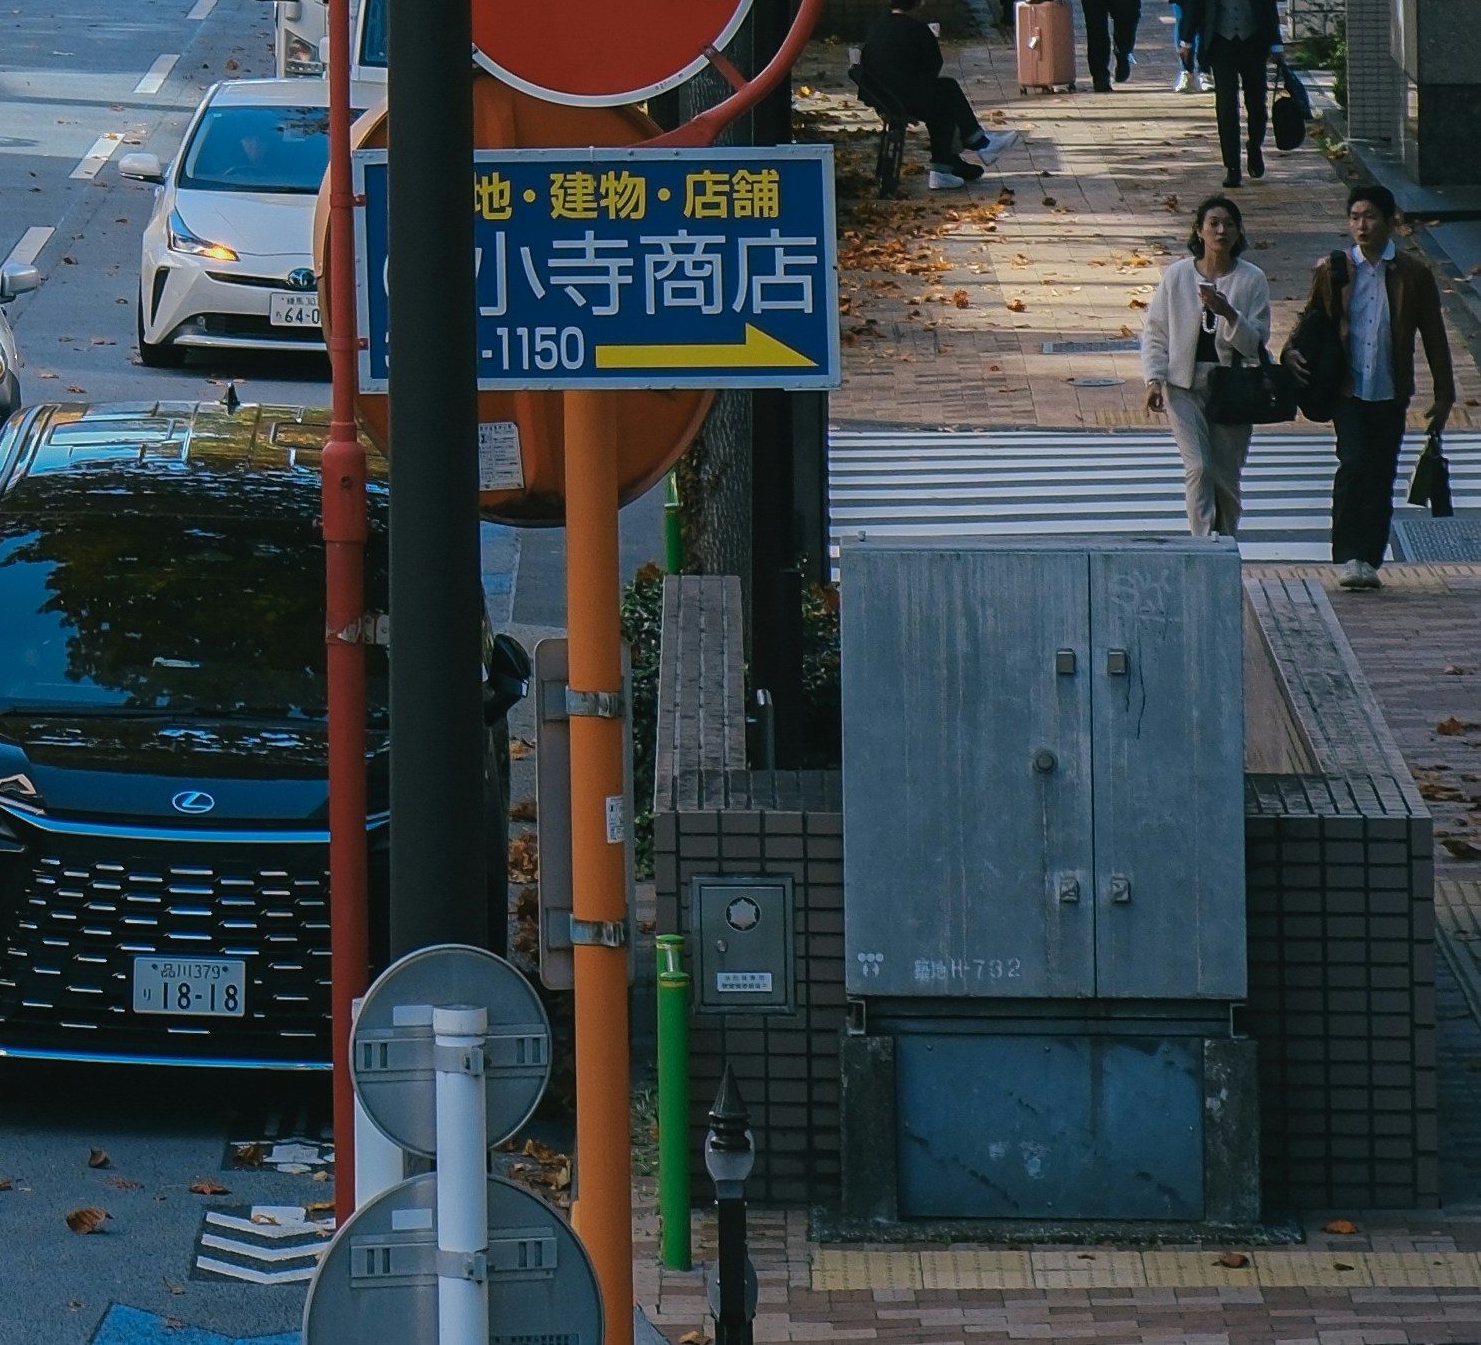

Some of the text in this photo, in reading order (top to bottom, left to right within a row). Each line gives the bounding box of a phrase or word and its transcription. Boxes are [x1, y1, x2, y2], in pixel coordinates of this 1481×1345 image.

[475, 227, 819, 317] 小寺商店
[284, 307, 320, 325] 64-0
[160, 963, 221, 980] 品川379
[162, 982, 239, 1012] 18-18
